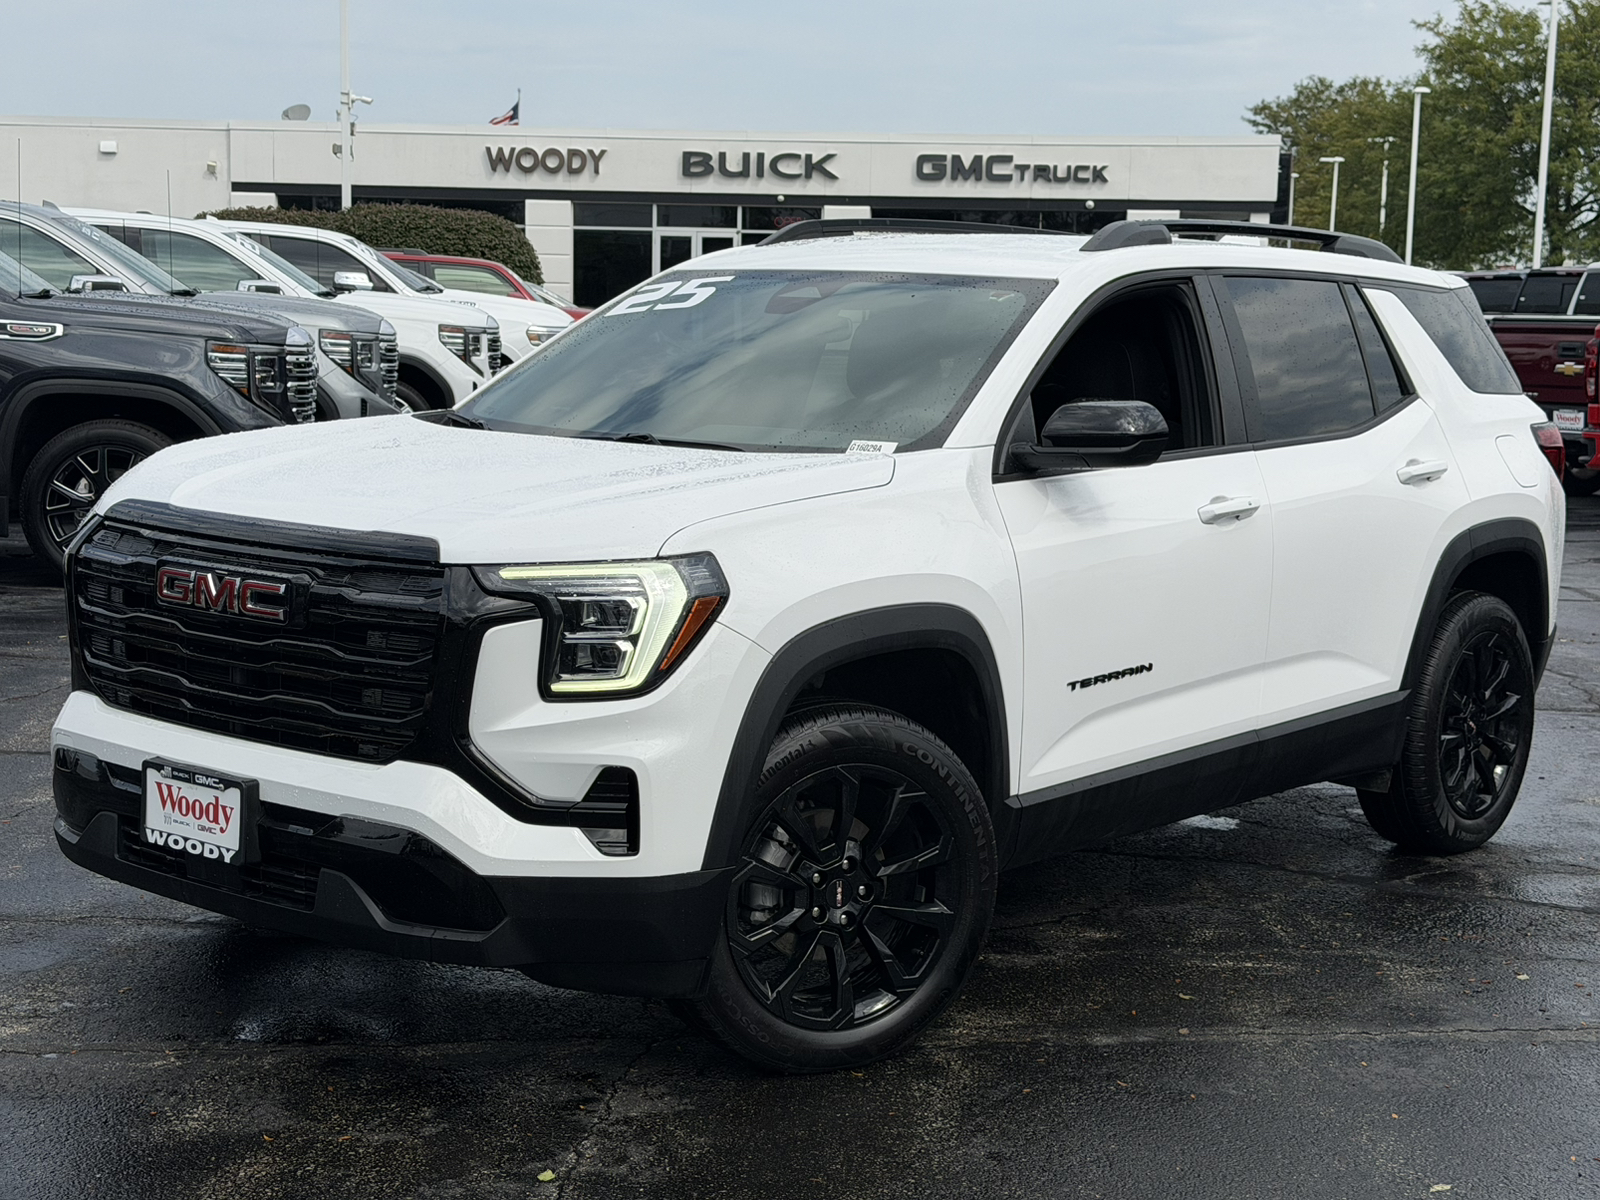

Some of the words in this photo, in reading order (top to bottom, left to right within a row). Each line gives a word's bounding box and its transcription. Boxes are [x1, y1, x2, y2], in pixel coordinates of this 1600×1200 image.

[485, 146, 607, 175] WOODY
[682, 151, 839, 180] BUICK
[604, 276, 736, 317] 25
[1556, 413, 1581, 425] Woody
[849, 443, 883, 453] G16029A
[157, 566, 286, 621] GMC
[1066, 662, 1153, 692] TERRAIN
[172, 770, 190, 779] BUICK
[194, 774, 220, 787] GMC
[154, 781, 235, 834] Woody
[172, 819, 191, 828] BUICK
[197, 823, 217, 835] GMC
[145, 828, 236, 864] WOODY
